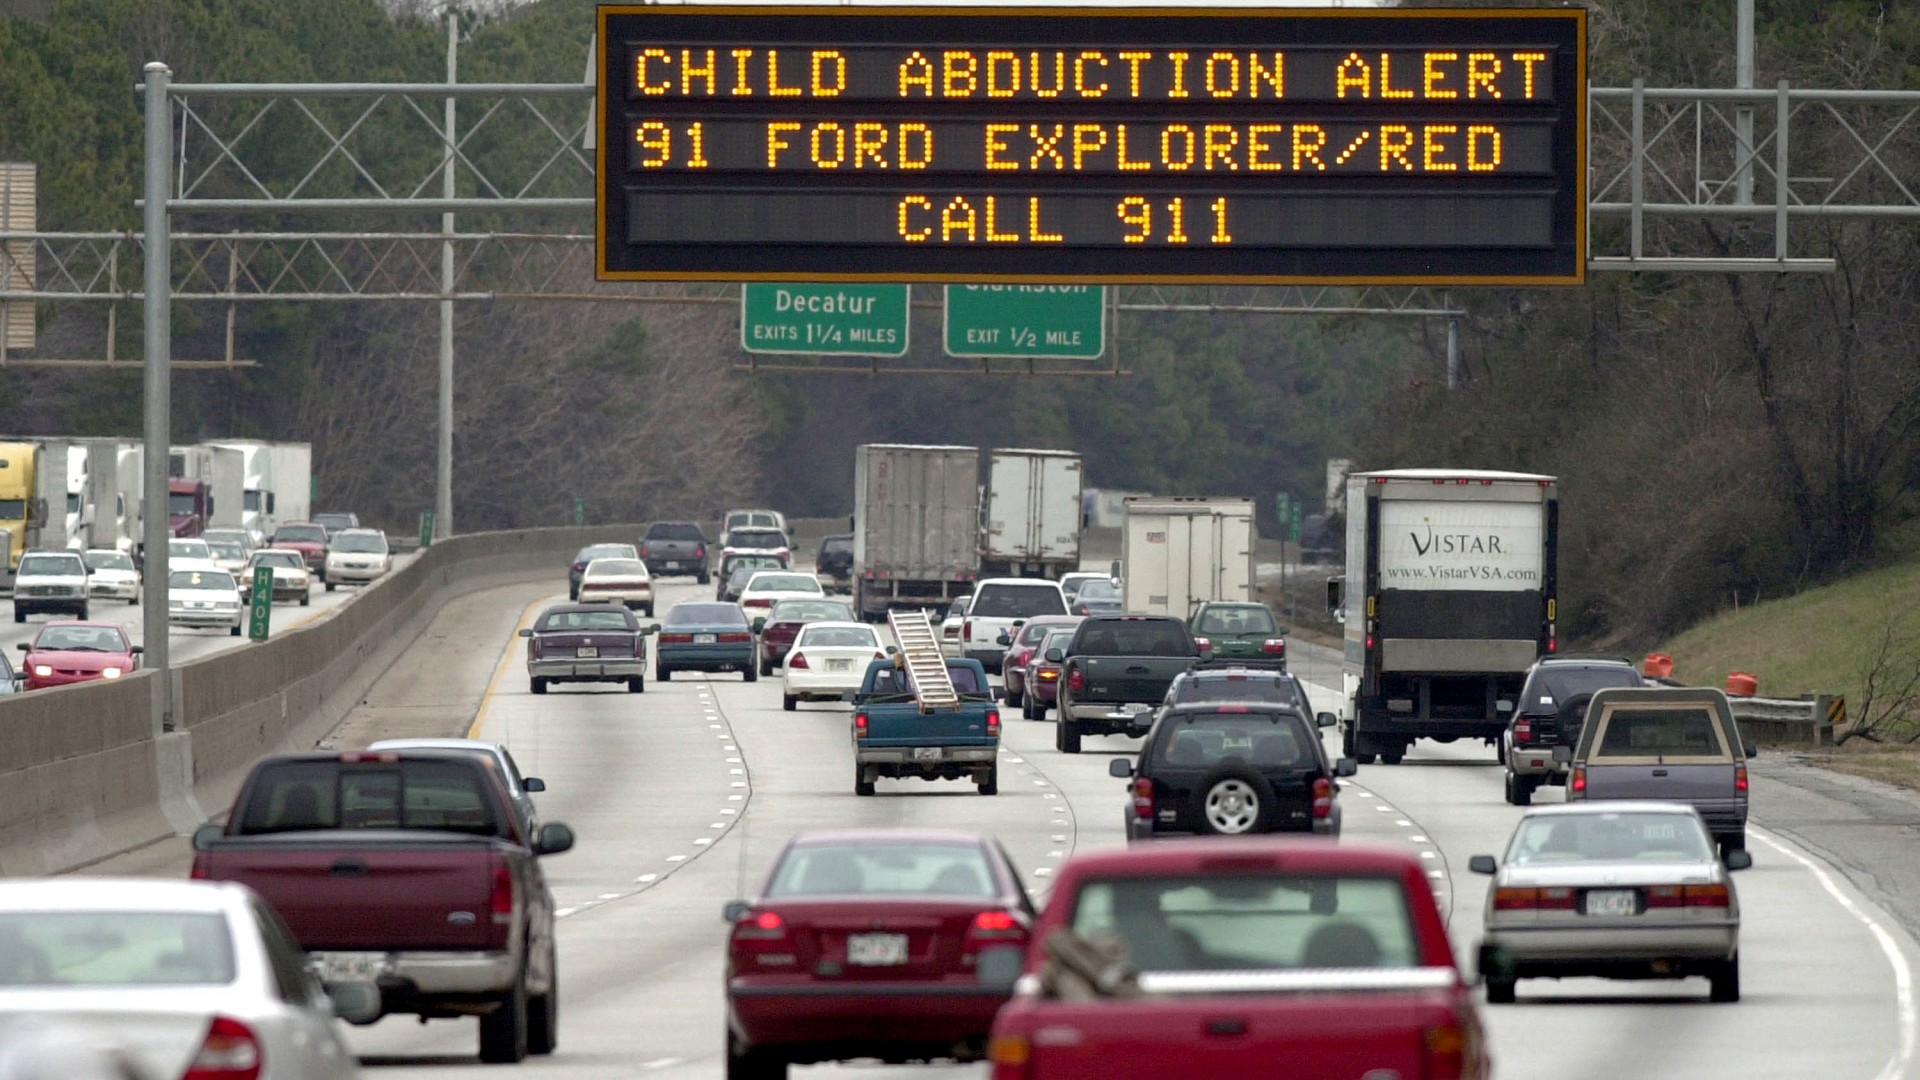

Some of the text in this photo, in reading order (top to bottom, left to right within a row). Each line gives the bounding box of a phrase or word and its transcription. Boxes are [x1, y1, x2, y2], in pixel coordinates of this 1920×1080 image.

[636, 48, 1546, 99] CHILD ABDUCTION ALERT
[635, 121, 1501, 172] 91 FORD EXPLORER/RED
[898, 195, 1233, 244] CALL 911
[776, 290, 876, 313] Decatur
[754, 325, 798, 340] EXITS
[850, 328, 896, 343] MILES
[967, 328, 1000, 344] EXIT
[1046, 331, 1081, 346] MILE
[1388, 565, 1537, 580] www.VistarVSA.com
